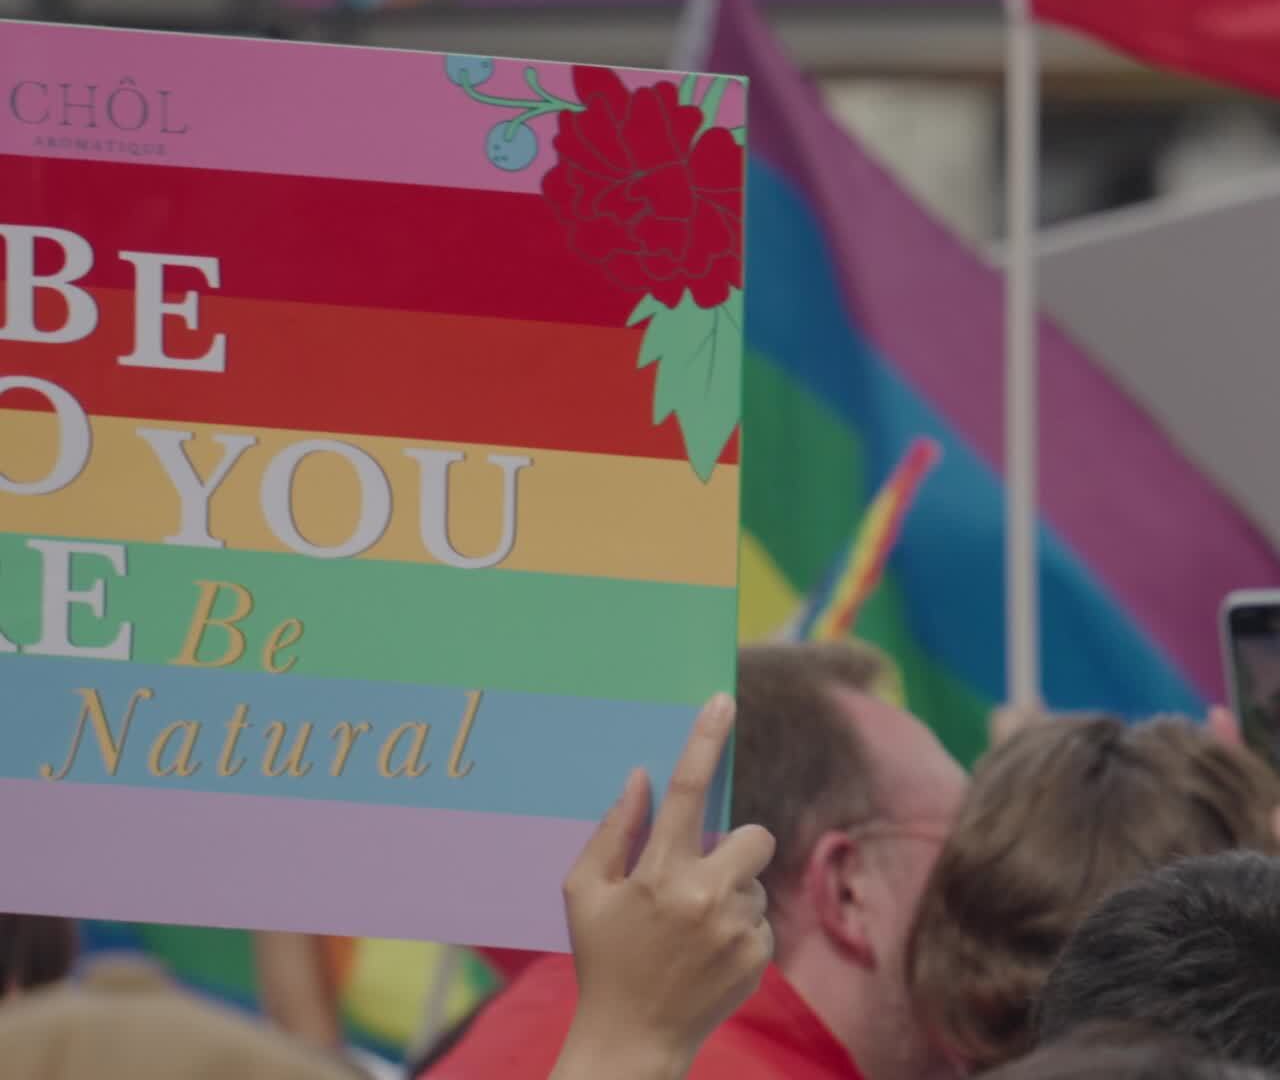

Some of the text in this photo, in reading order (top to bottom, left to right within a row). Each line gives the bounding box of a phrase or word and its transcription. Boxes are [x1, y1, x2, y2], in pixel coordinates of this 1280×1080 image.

[9, 75, 191, 134] CHÔL
[0, 223, 227, 373] BE
[135, 426, 535, 569] YOU
[0, 538, 305, 674] E Be
[38, 687, 484, 781] Natural
